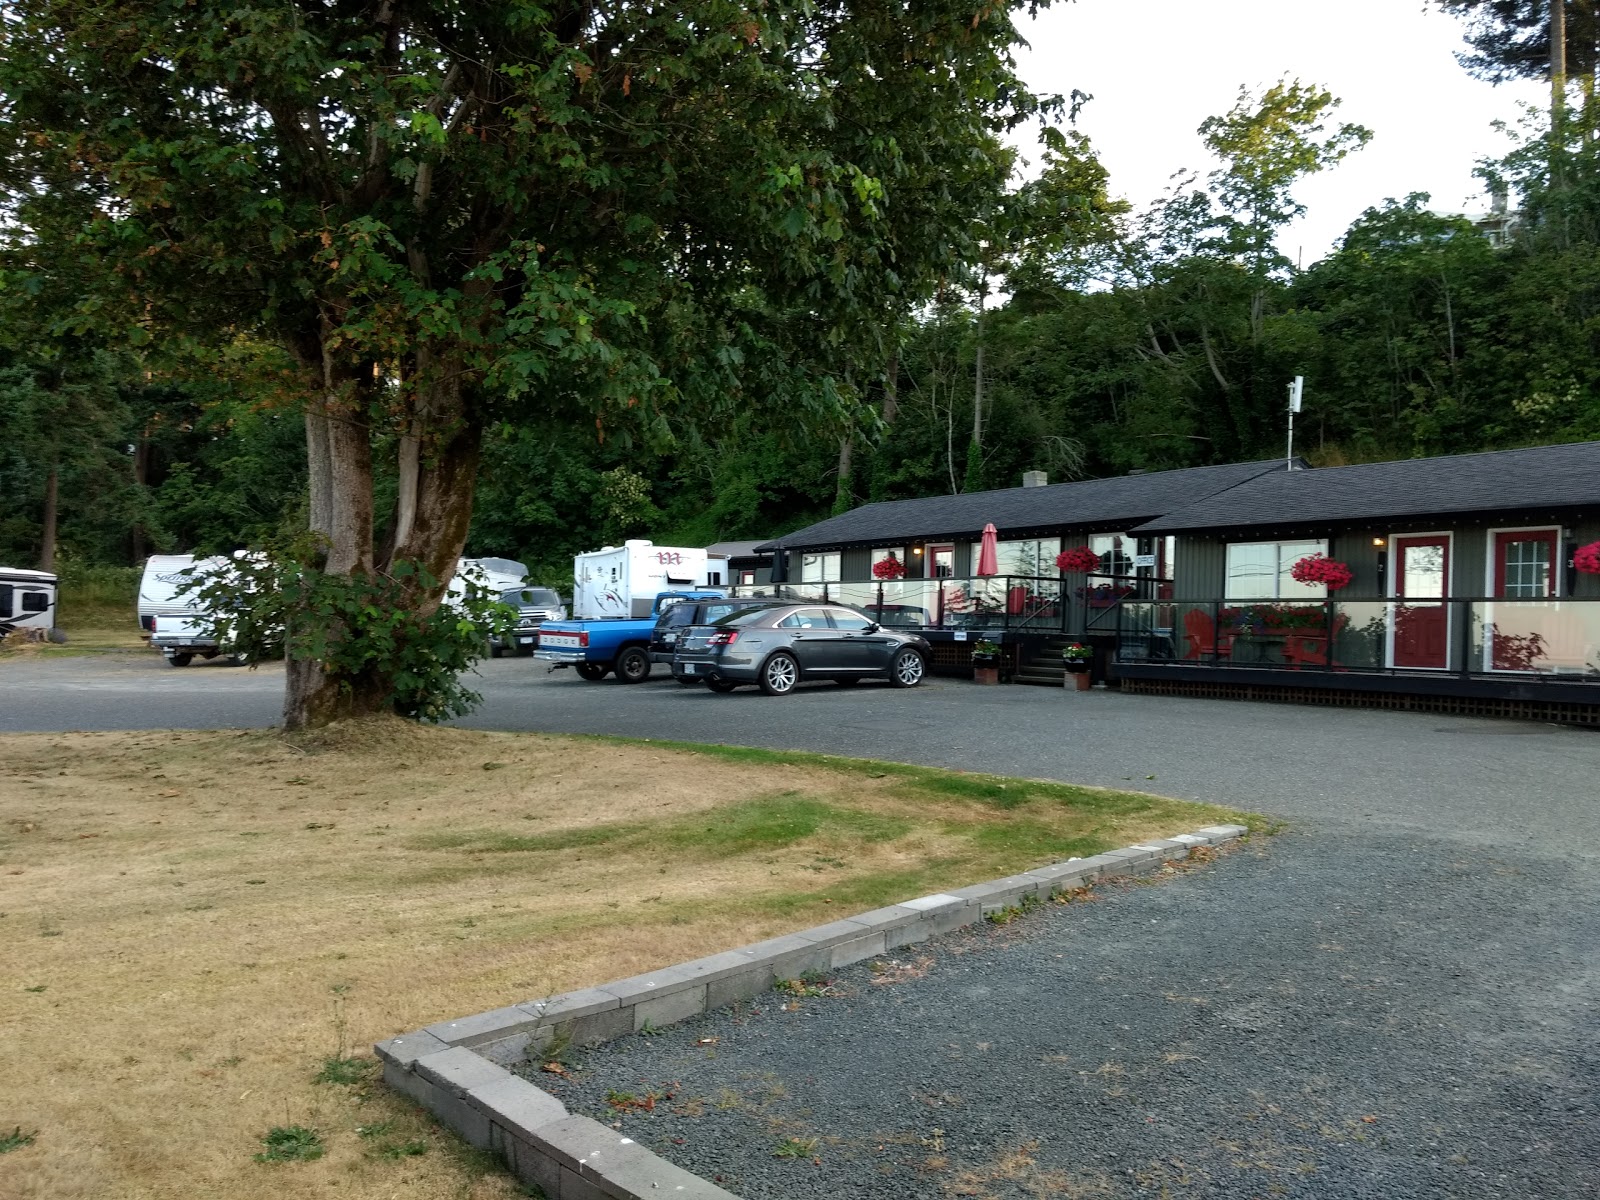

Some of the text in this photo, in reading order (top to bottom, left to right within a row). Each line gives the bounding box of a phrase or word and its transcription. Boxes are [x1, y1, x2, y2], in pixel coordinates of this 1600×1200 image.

[1137, 556, 1154, 565] OFFICE
[1567, 559, 1575, 568] 3
[1377, 564, 1384, 572] 2
[543, 637, 576, 645] DODGE
